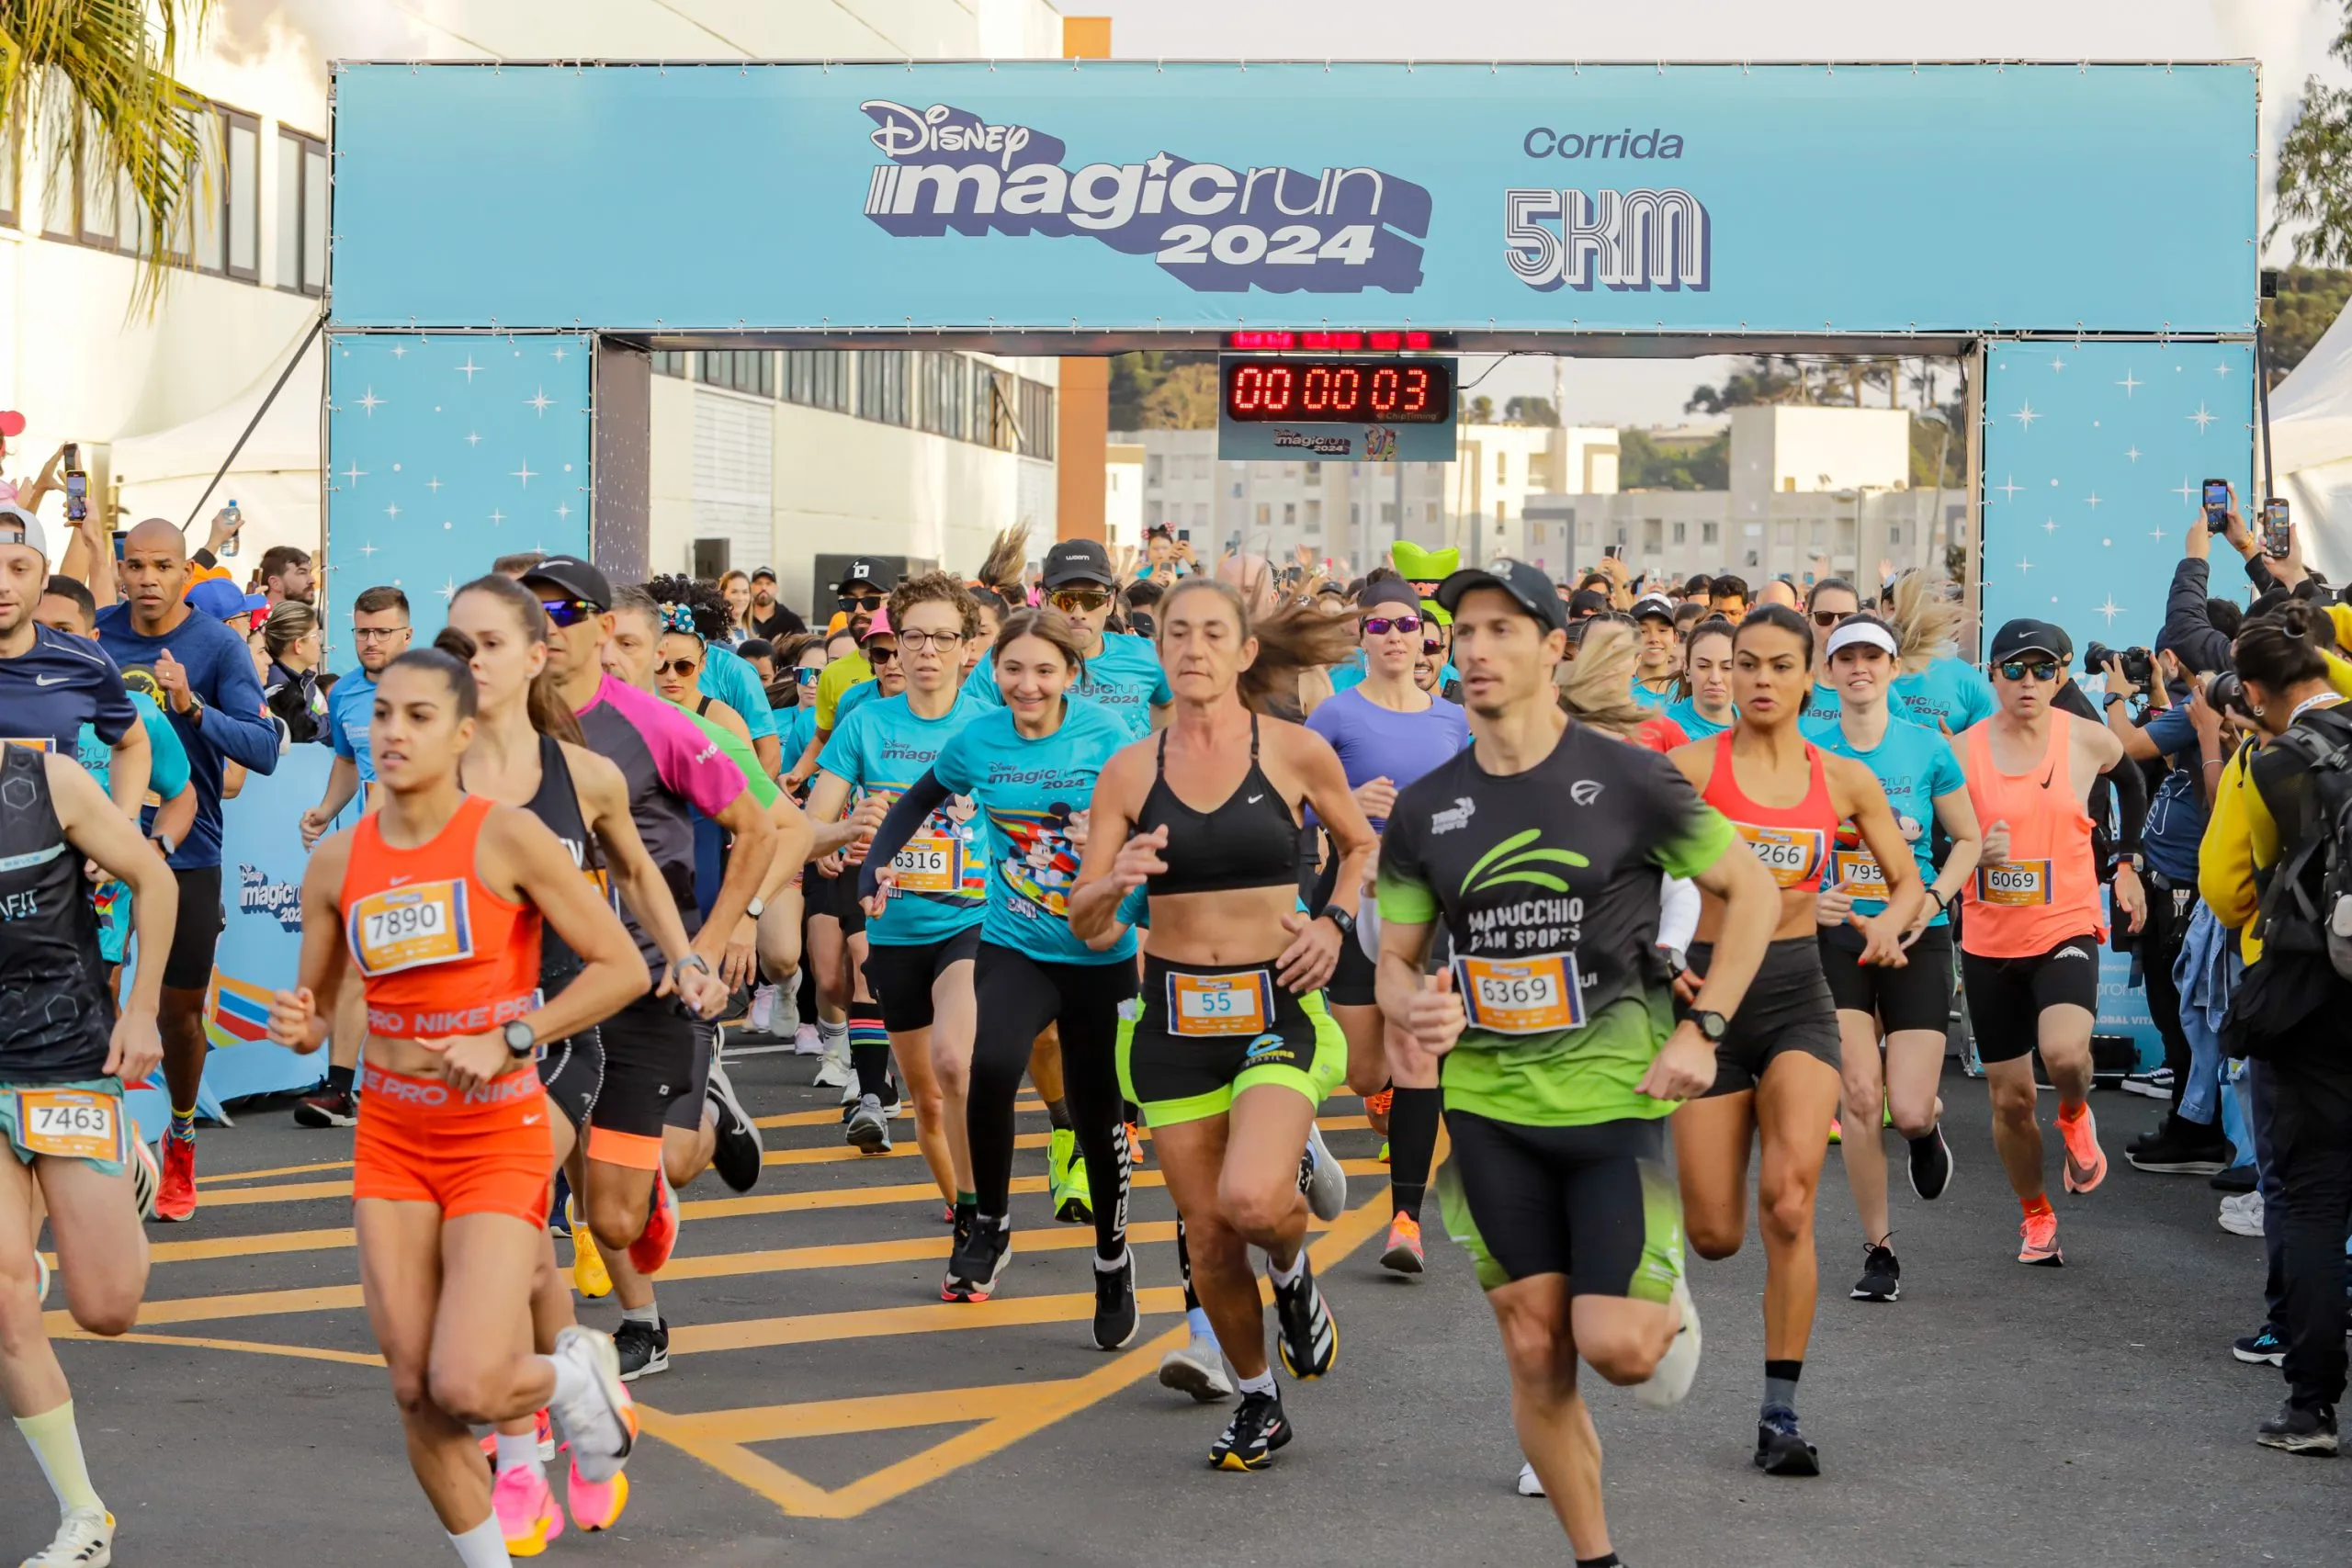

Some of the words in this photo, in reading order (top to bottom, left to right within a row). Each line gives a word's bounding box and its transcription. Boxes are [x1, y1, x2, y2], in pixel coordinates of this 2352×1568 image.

[859, 100, 1029, 171] Disney
[1523, 127, 1684, 159] Corrida
[1156, 224, 1375, 265] 2024
[1505, 188, 1708, 289] 5KM
[1100, 695, 1139, 704] 2024
[1913, 705, 1950, 716] 2024
[1041, 779, 1085, 790] 2024
[894, 851, 942, 869] 6316
[1991, 871, 2034, 887] 6069
[370, 904, 436, 940] 7890
[1202, 992, 1231, 1011] 55
[1482, 976, 1547, 1003] 6369
[414, 1007, 491, 1032] NIKE
[382, 1077, 448, 1106] PRO
[464, 1072, 538, 1105] NIKE
[39, 1108, 105, 1131] 7463
